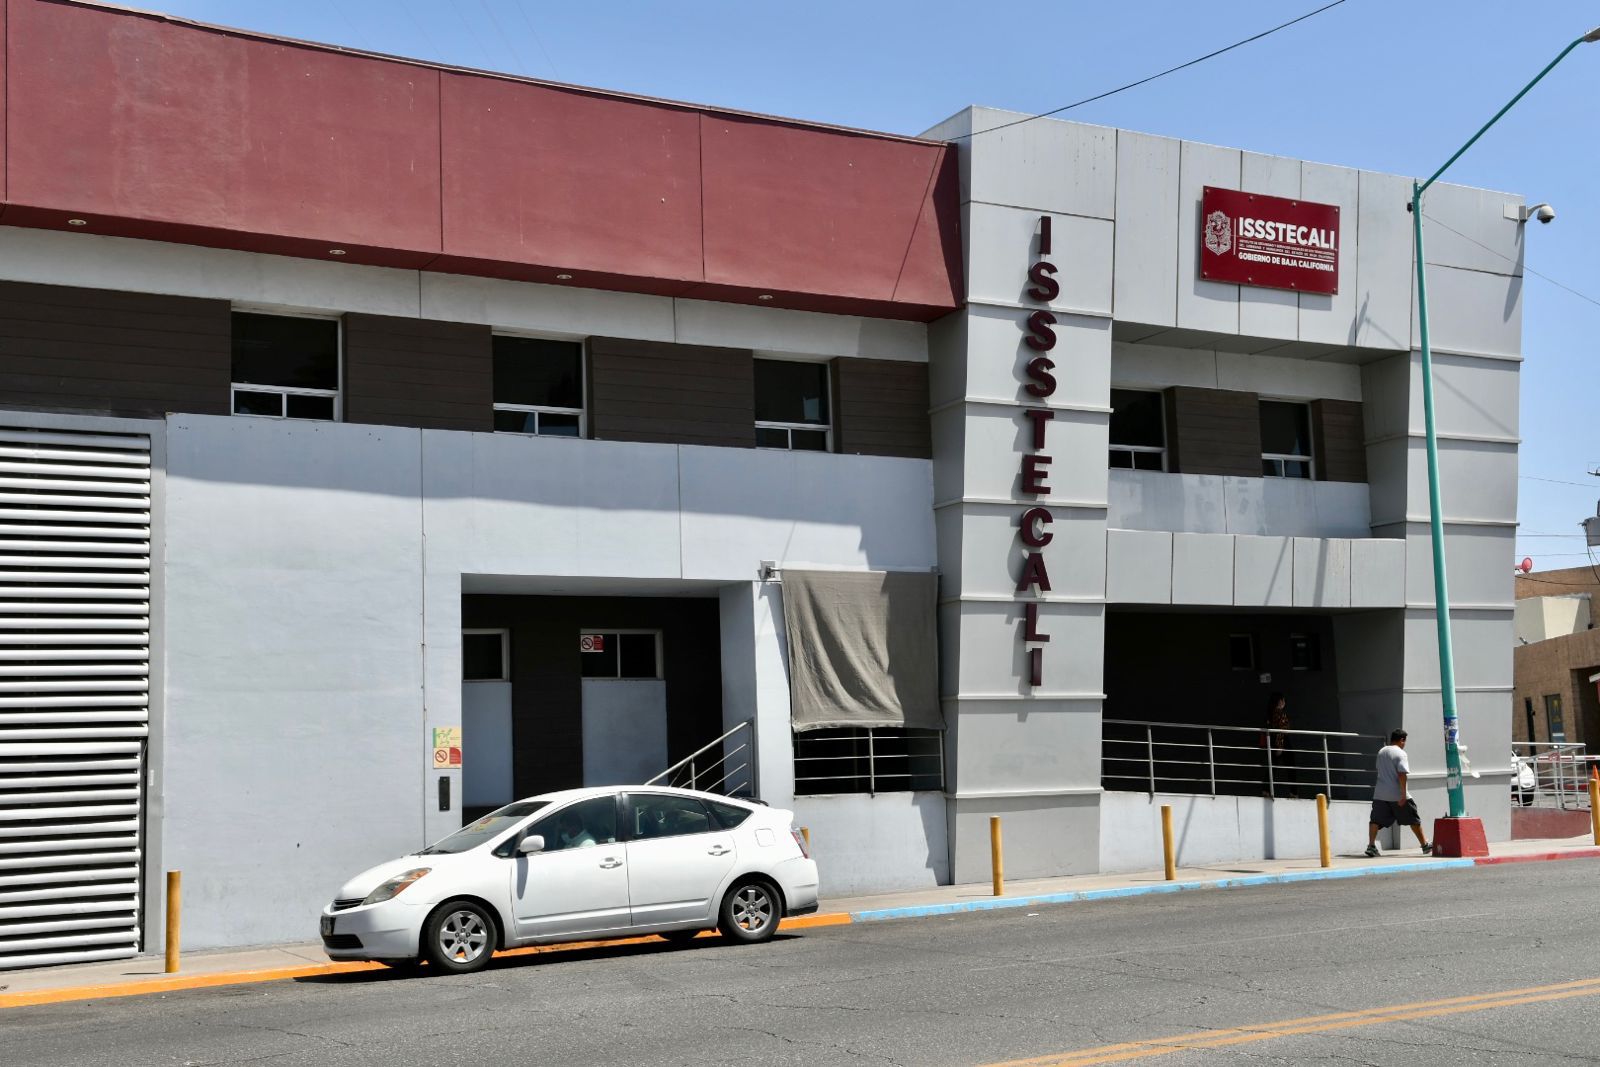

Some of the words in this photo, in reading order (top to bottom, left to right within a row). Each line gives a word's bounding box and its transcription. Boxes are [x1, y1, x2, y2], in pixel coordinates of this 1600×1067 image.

[1239, 217, 1335, 249] ISSSTECALI
[1238, 252, 1271, 263] GOBIERNO
[1272, 256, 1280, 264] DE
[1281, 258, 1298, 267] BAJA
[1298, 260, 1334, 272] CALIFORNIA
[1018, 216, 1060, 686] ISSSTECALI
